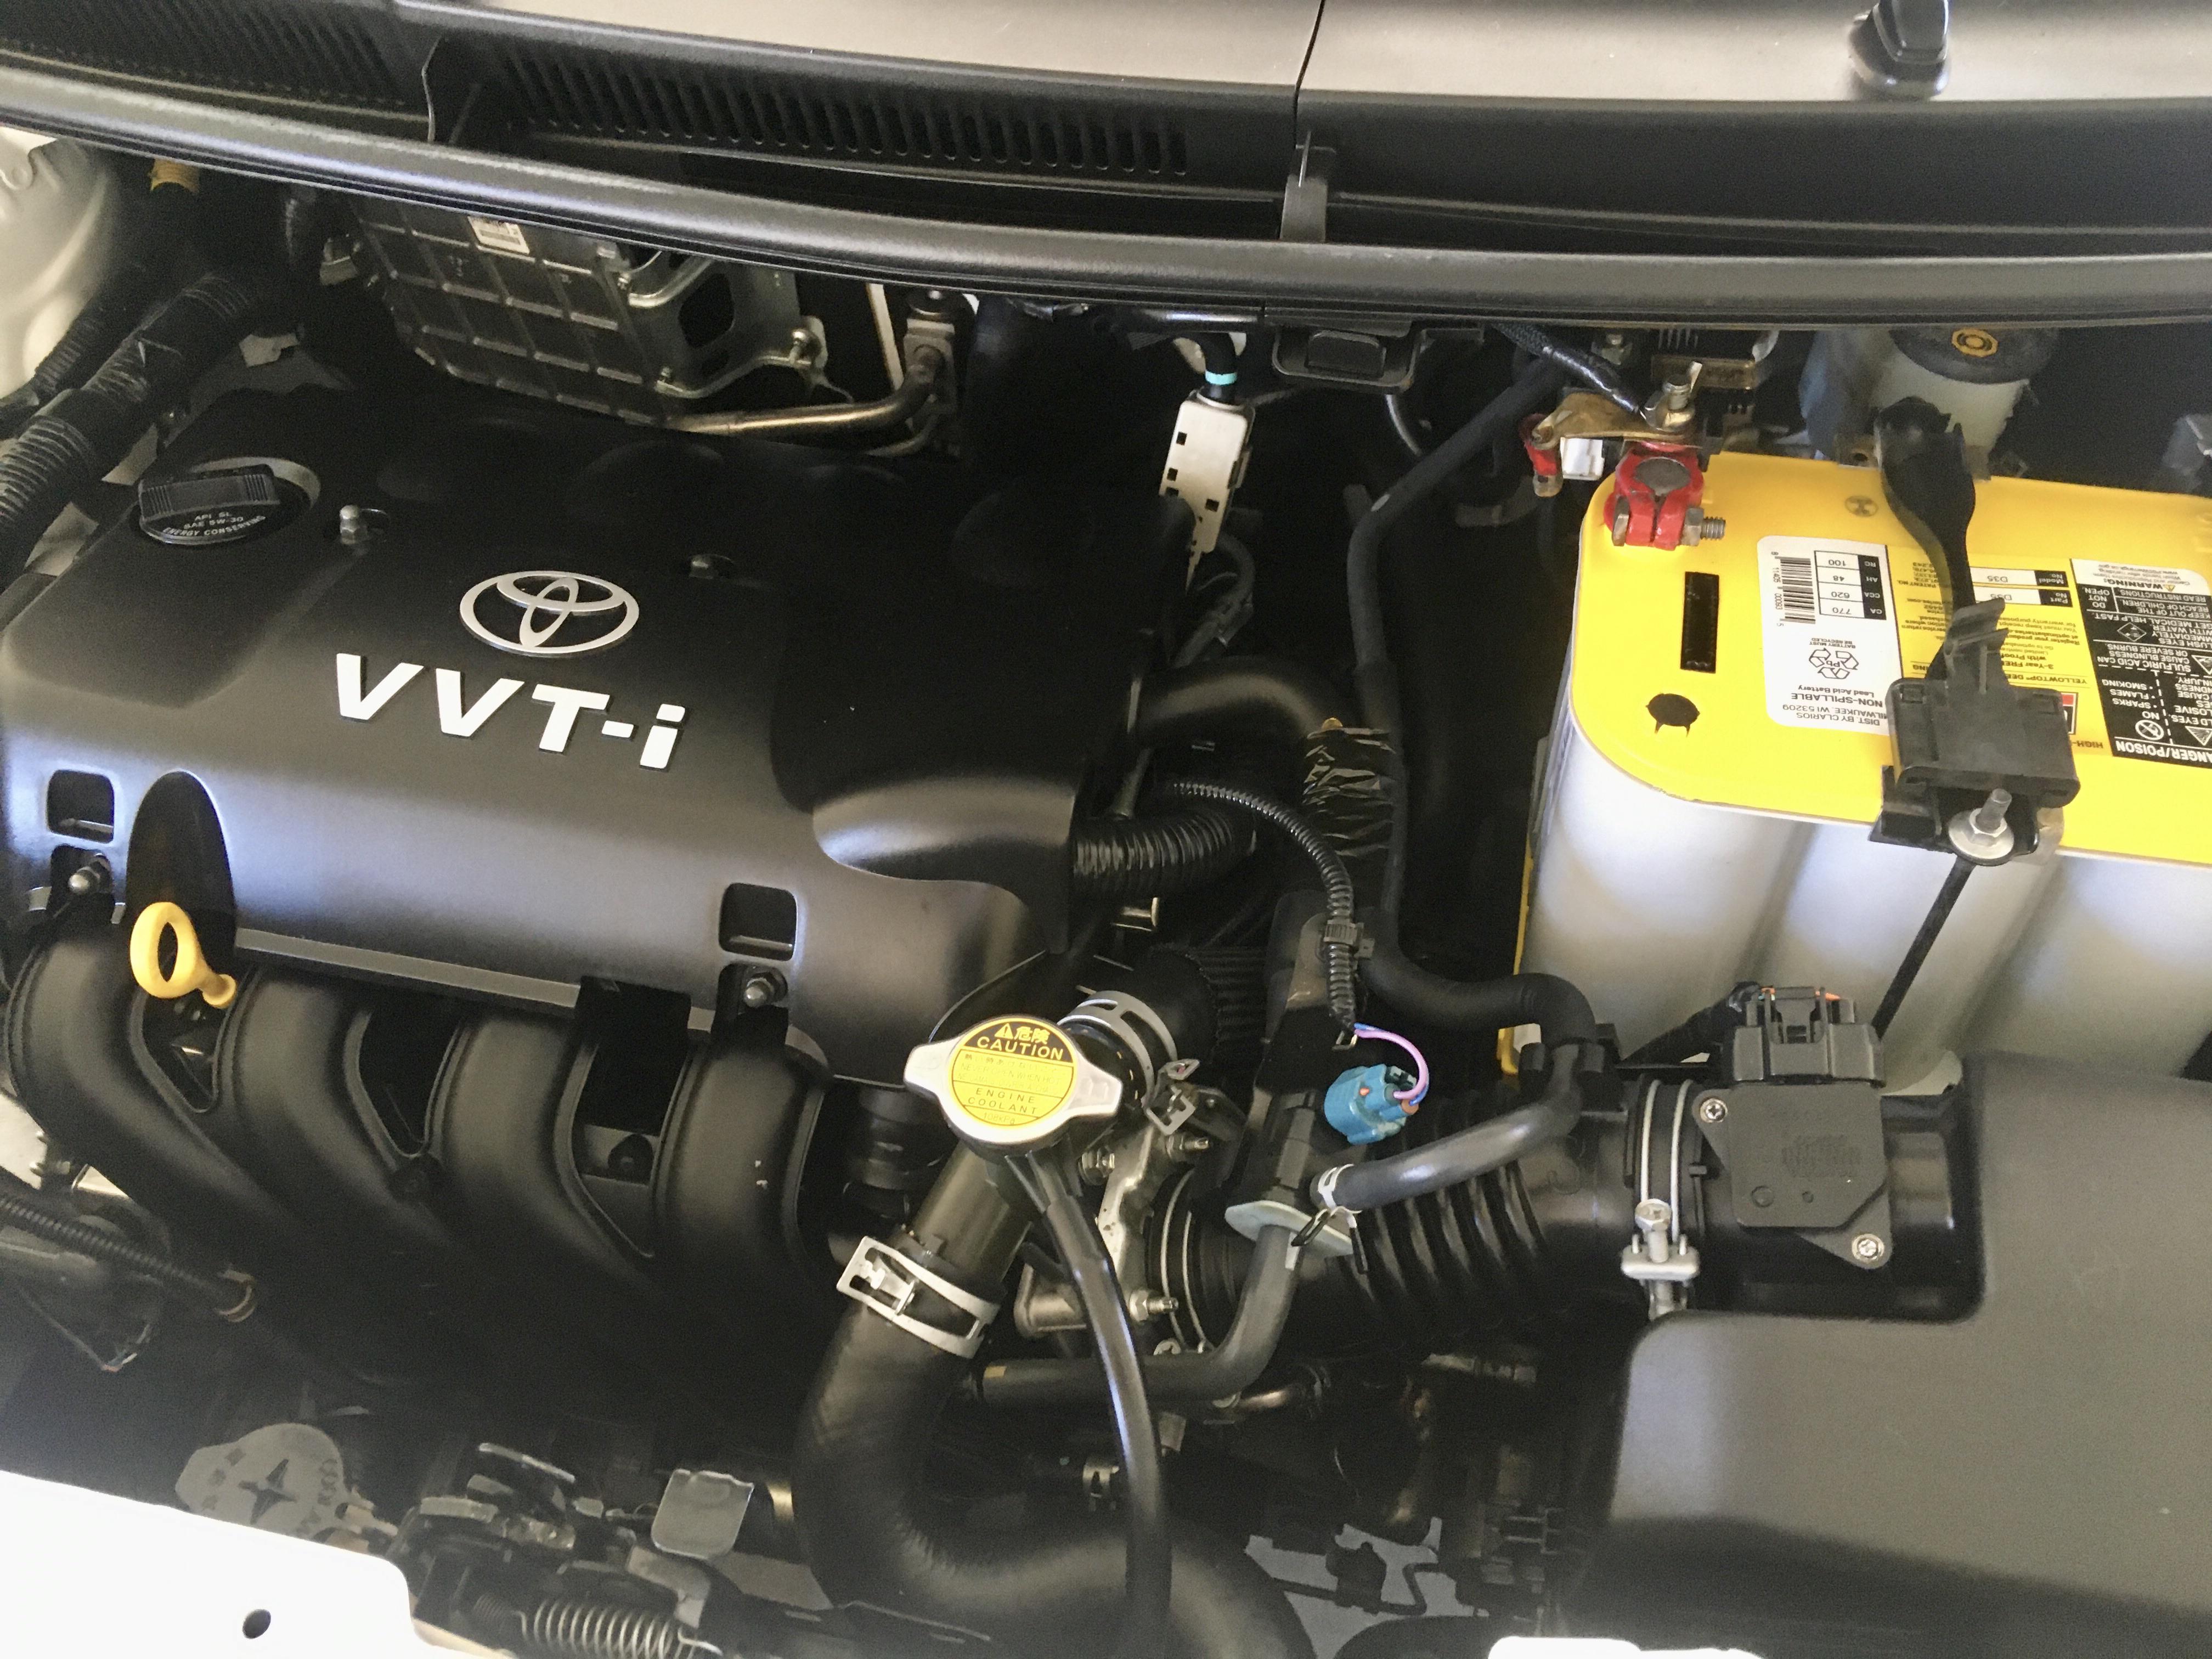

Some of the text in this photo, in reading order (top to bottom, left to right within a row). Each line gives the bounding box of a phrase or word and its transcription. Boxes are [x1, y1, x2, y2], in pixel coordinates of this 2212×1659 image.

[2179, 605, 2209, 613] REACH
[2091, 613, 2119, 621] FAST.
[2121, 615, 2147, 624] HELP
[2188, 611, 2210, 619] KEEP
[2149, 618, 2192, 628] MEDICAL
[2152, 630, 2212, 642] MMEDIATELY
[2104, 643, 2138, 652] BURNS.
[2158, 637, 2212, 648] LUSH EYES
[2140, 646, 2174, 656] SEVERE
[2108, 650, 2190, 664] CAUSE BLINDNESS
[2097, 656, 2191, 673] SULFURIC ACID CAN
[1798, 685, 1831, 693] Battery
[2101, 679, 2147, 691] SMOKING
[2109, 689, 2149, 699] FLAMES
[2177, 690, 2210, 701] CAUSE
[1791, 693, 1883, 708] NON-SPILLABLE
[2112, 698, 2152, 709] SPARKS
[336, 652, 686, 770] VVT-i
[2142, 710, 2160, 720] NO
[2174, 704, 2212, 717] LOSIVE
[1796, 713, 1839, 721] CLARIOS
[1857, 717, 1881, 726] DIST.
[2115, 741, 2212, 764] ANGER/POISON
[1014, 1026, 1050, 1045] 危険
[977, 1036, 1064, 1060] CAUTION
[975, 1087, 1036, 1103] ENGINE
[967, 1097, 1039, 1115] COOLANT
